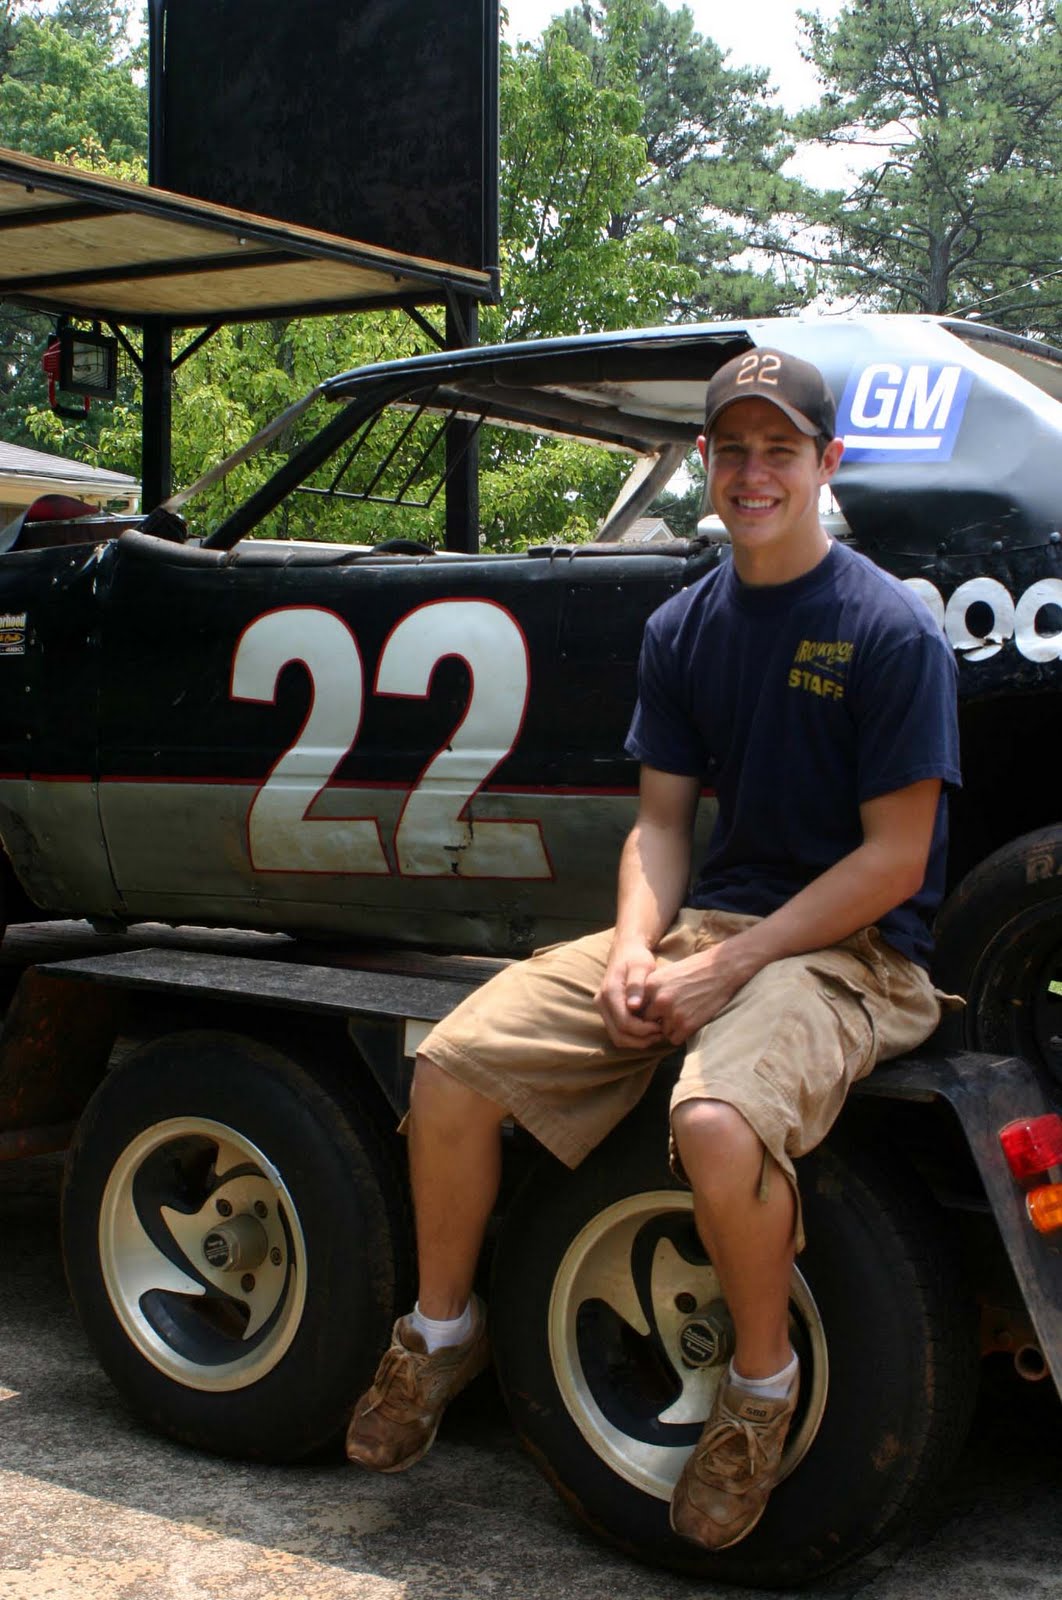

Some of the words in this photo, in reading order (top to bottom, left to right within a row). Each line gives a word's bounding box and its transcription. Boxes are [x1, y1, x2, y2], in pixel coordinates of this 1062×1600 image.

[736, 354, 781, 385] 22
[850, 363, 961, 430] GM
[788, 668, 844, 700] STAFF
[229, 597, 556, 882] 22
